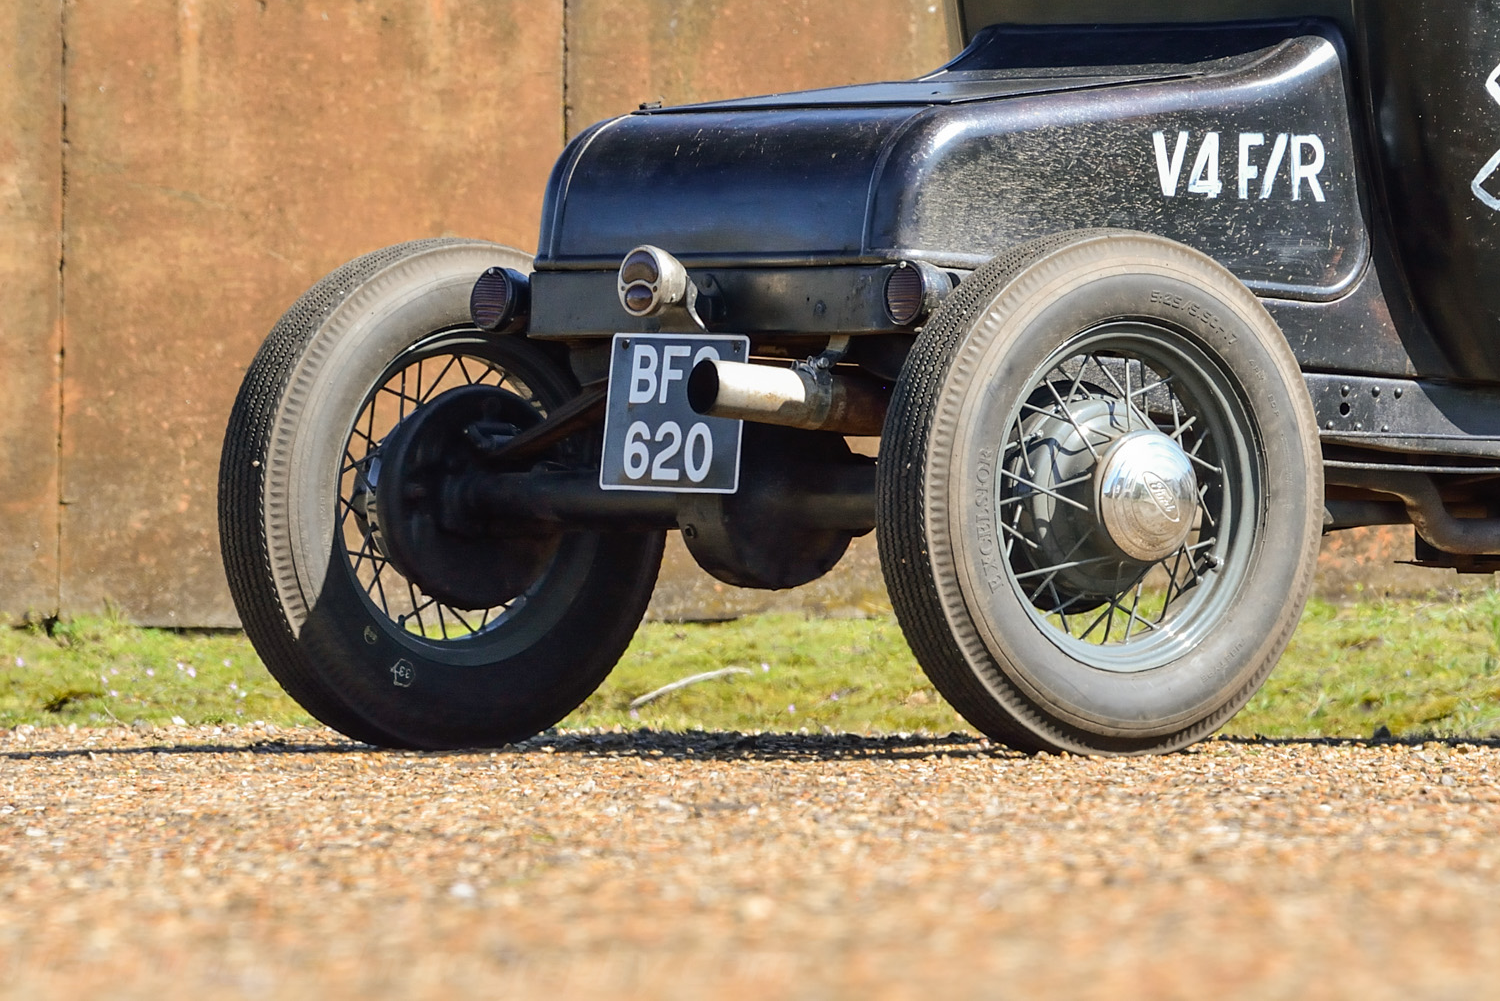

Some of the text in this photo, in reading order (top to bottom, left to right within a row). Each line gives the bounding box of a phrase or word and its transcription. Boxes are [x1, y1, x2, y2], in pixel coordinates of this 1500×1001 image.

[1152, 131, 1327, 203] V4 F/R
[628, 344, 721, 404] BF
[623, 420, 713, 483] 620
[976, 446, 1005, 595] EXCELSIOR
[1151, 474, 1179, 519] Ford
